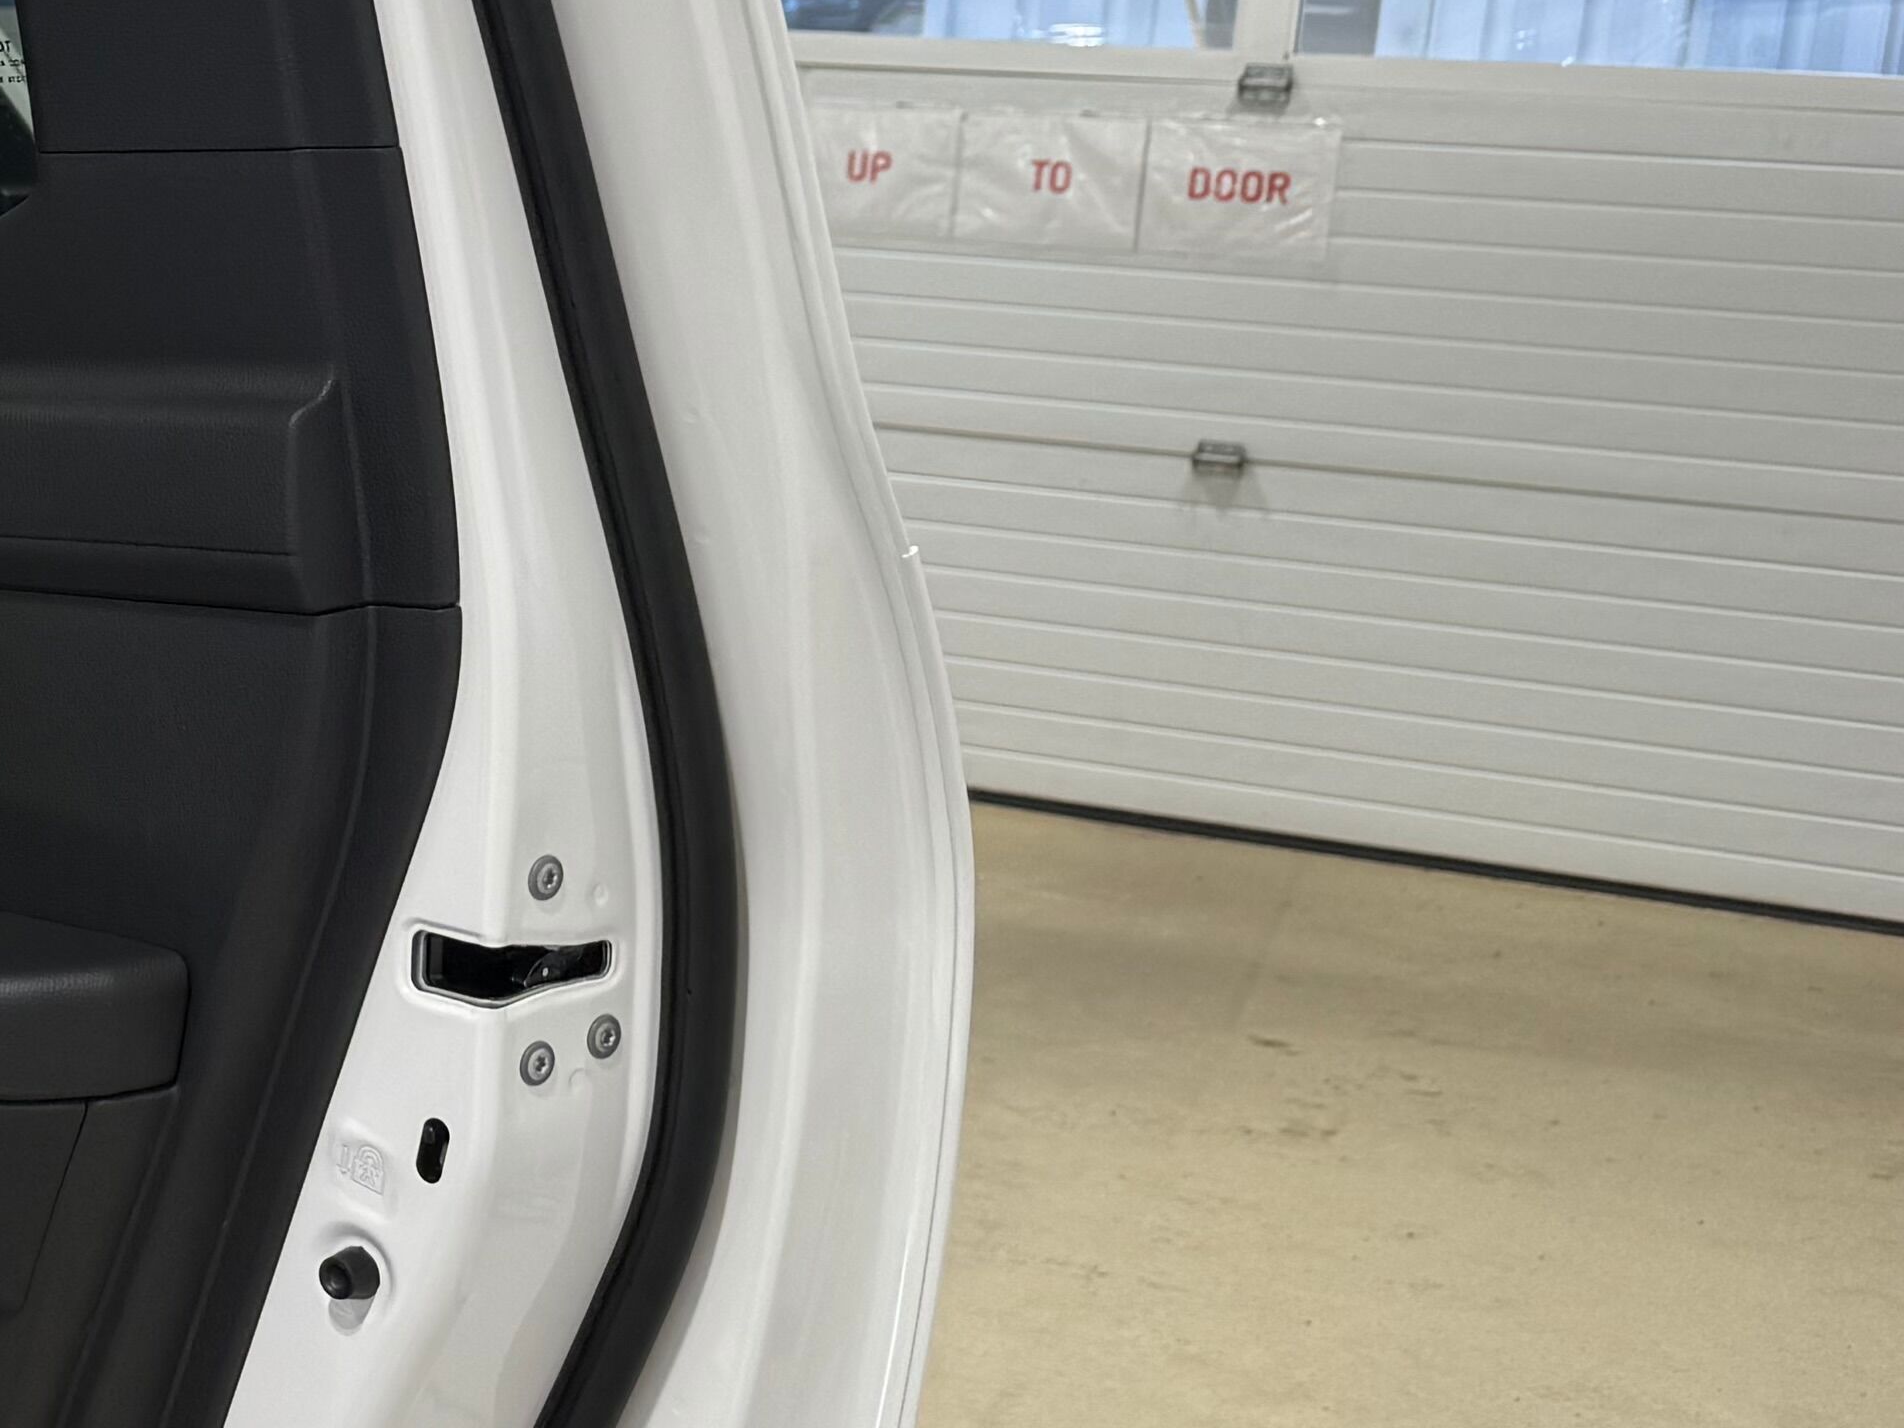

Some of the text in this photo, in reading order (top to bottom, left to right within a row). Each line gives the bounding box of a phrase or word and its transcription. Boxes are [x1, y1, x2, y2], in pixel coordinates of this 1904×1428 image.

[847, 149, 1291, 206] UP TO DOOR
